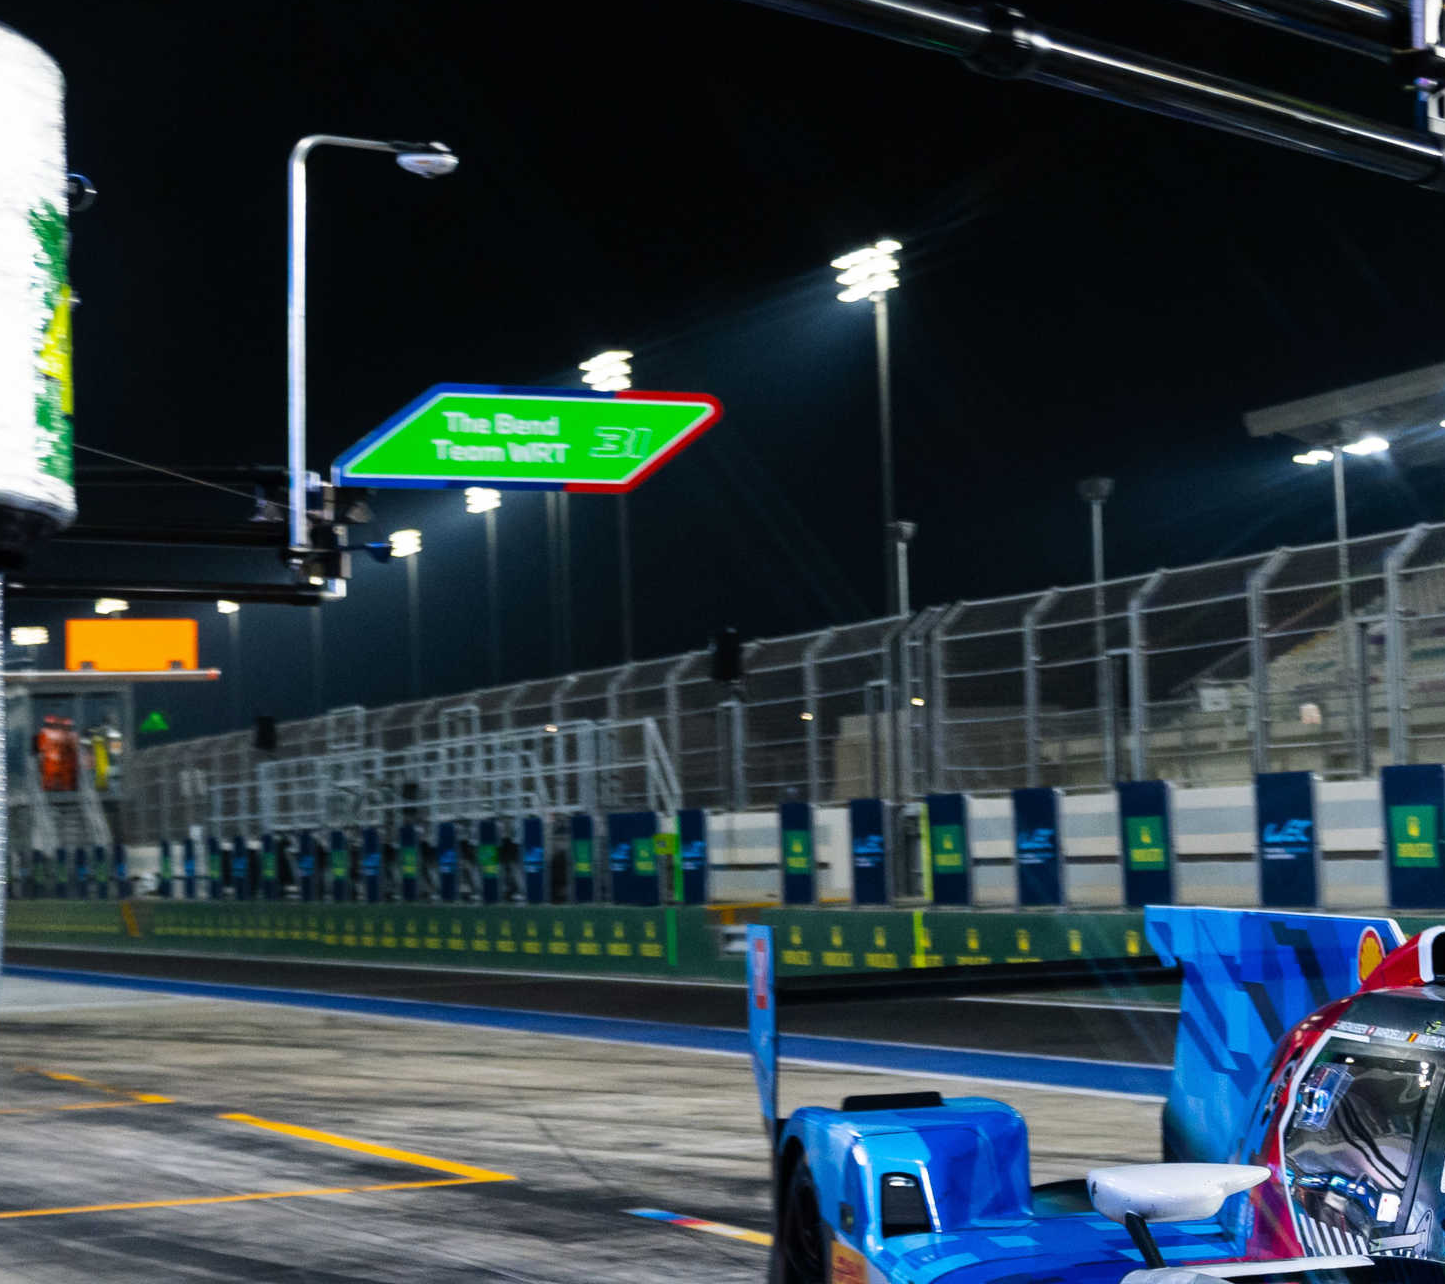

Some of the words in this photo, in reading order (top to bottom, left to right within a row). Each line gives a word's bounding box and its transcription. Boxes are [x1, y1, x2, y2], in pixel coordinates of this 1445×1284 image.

[441, 410, 491, 436] The
[493, 412, 561, 436] Bend
[430, 438, 505, 463] Team
[507, 442, 570, 465] WRT
[589, 426, 653, 459] 31
